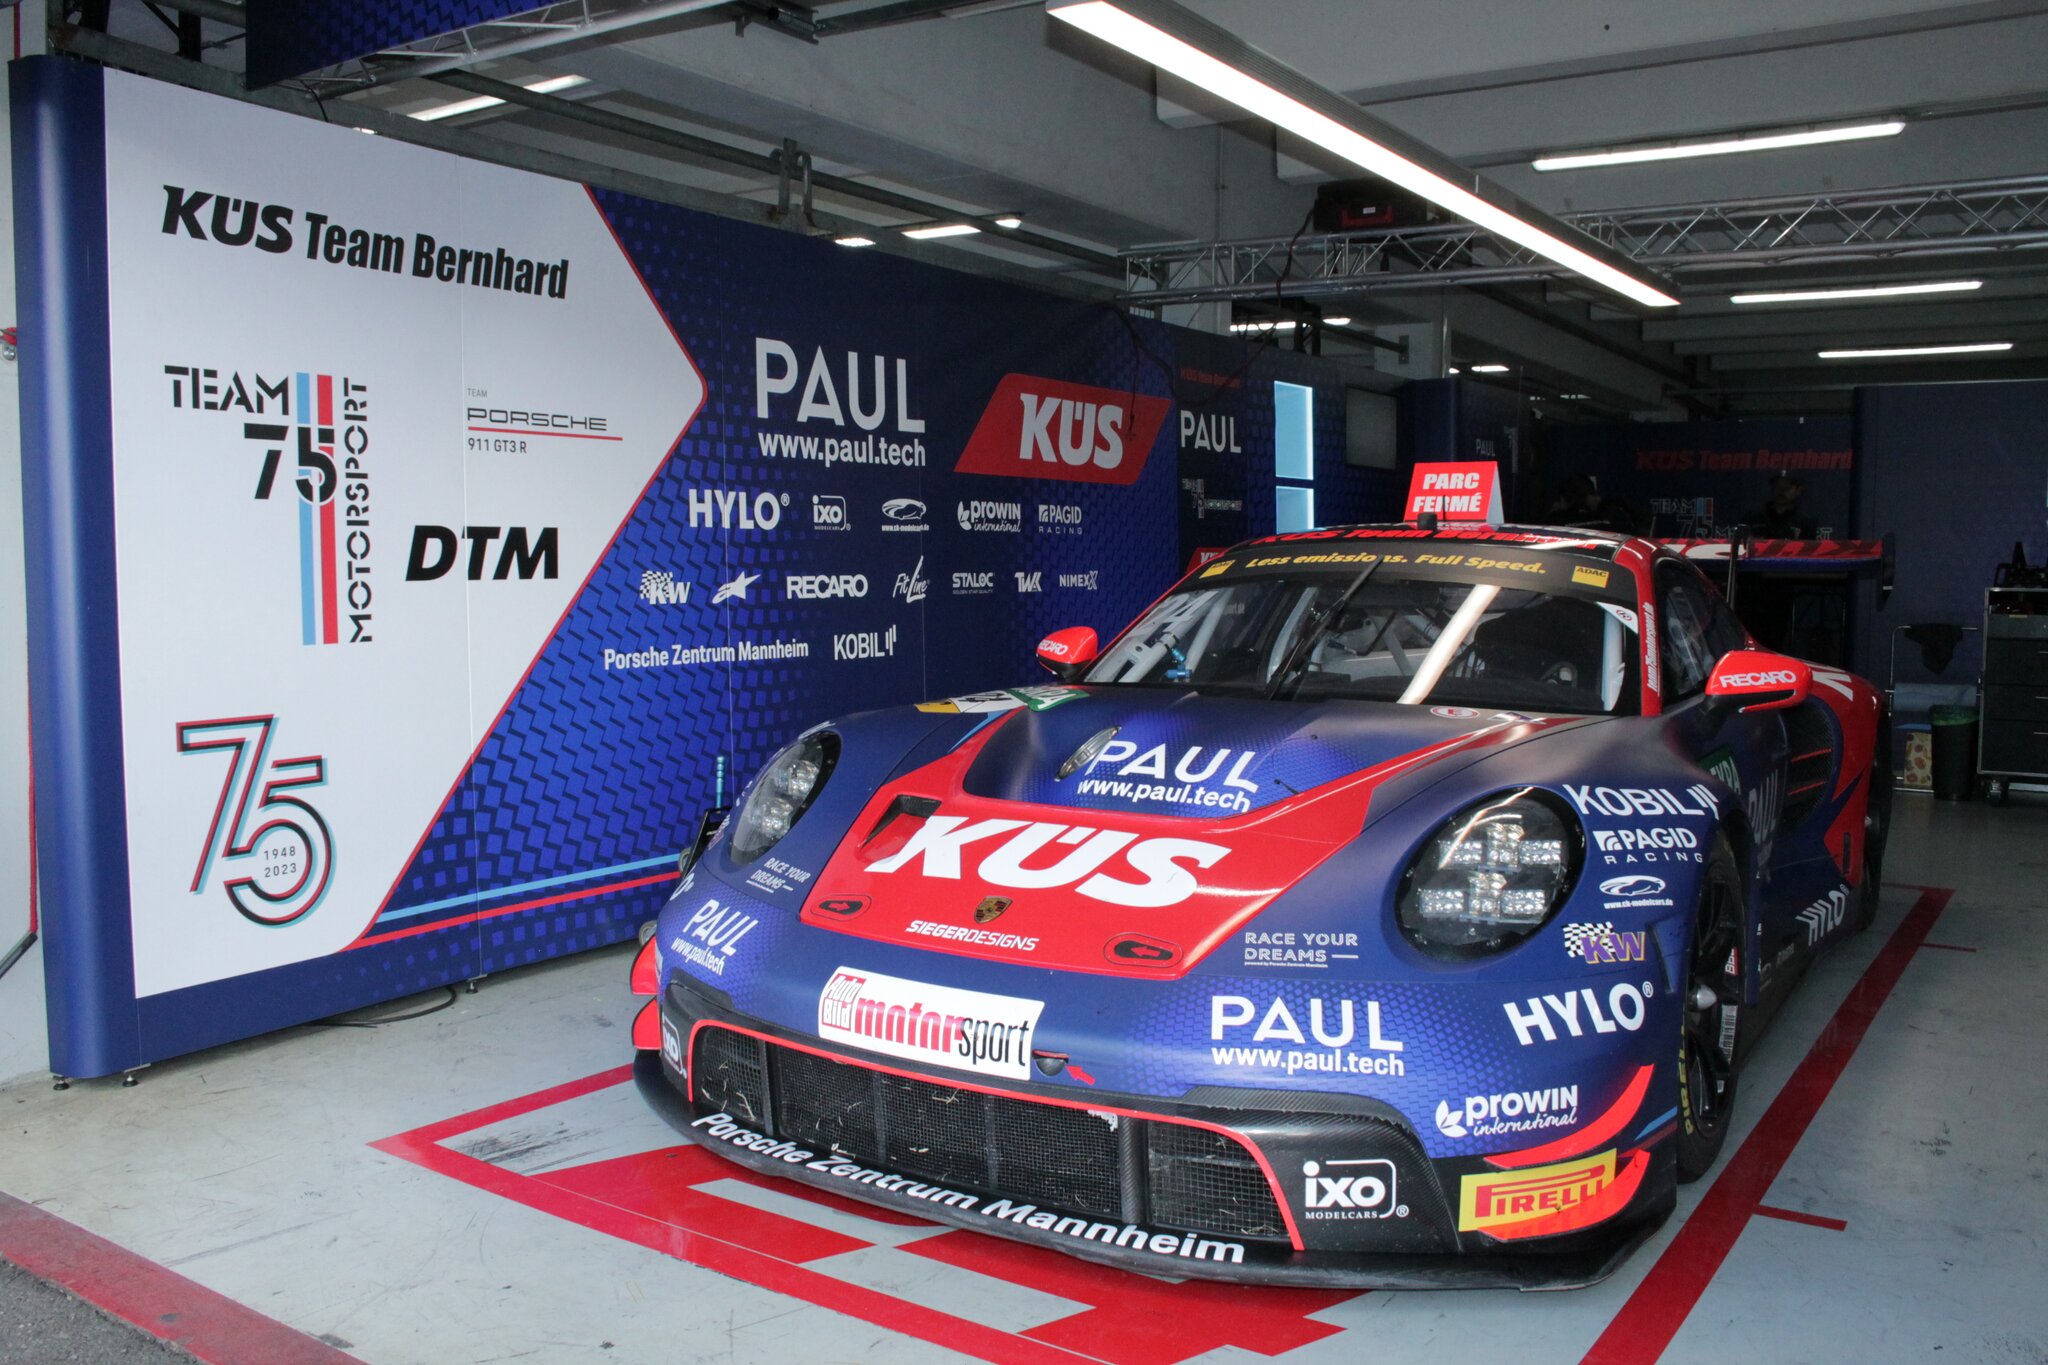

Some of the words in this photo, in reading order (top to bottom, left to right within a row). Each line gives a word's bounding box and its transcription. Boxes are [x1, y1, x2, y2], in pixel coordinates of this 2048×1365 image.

[162, 184, 293, 253] KÜS
[305, 213, 404, 274] Team
[412, 233, 569, 300] Bernhard
[164, 364, 290, 416] TEAM
[467, 387, 488, 398] TEAM
[755, 337, 926, 434] PAUL
[467, 408, 608, 431] PORSCHE
[1019, 392, 1124, 469] KÜS
[1180, 410, 1242, 454] PAUL
[468, 438, 490, 451] 911
[494, 439, 517, 453] GT3
[520, 441, 527, 453] R
[758, 432, 926, 468] www.paul.tech
[1699, 450, 1749, 470] Team
[1756, 449, 1853, 470] Bernhard
[244, 423, 338, 505] 75
[1422, 472, 1480, 490] PARC
[343, 377, 373, 643] MOTORSPORT
[812, 495, 843, 524] ixo
[1050, 505, 1082, 524] PAGID
[1412, 492, 1482, 513] FERMÉ
[1651, 498, 1696, 514] TEAM
[974, 517, 1022, 533] international
[1039, 526, 1083, 535] RACING
[405, 525, 559, 581] DTM
[1245, 554, 1291, 568] Less
[1415, 554, 1465, 566] Full
[1464, 556, 1547, 574] Speed.
[787, 574, 869, 599] RECARO
[952, 572, 994, 588] STALOC
[1575, 567, 1608, 578] ADAC
[649, 580, 691, 604] KW
[604, 648, 669, 670] Porsche
[672, 644, 735, 665] Zentrum
[738, 639, 809, 661] Mannheim
[834, 631, 886, 660] KOBIL
[1719, 670, 1797, 688] RECARO
[1085, 740, 1260, 794] PAUL
[1077, 778, 1253, 813] www.paul.tech
[1562, 784, 1705, 816] KOBIL
[176, 714, 338, 929] 75
[1617, 828, 1698, 849] PAGID
[263, 845, 297, 861] 1948
[864, 814, 1233, 909] KÜS
[1604, 852, 1703, 865] RACING
[264, 862, 298, 878] 2023
[750, 869, 786, 890] DREAMS
[764, 857, 788, 874] RACE
[787, 866, 811, 883] YOUR
[682, 899, 759, 957] PAUL
[905, 919, 1040, 951] SIEGERDESIGNS
[1245, 932, 1296, 945] RACE
[1303, 933, 1358, 946] YOUR
[671, 937, 726, 977] www.paul.tech
[1244, 948, 1327, 962] DREAMS
[1581, 932, 1646, 964] KW
[826, 975, 864, 1003] Auto
[823, 998, 851, 1030] Bild
[1211, 995, 1404, 1051] PAUL
[1212, 1047, 1405, 1076] www.paul.tech
[1473, 1108, 1577, 1136] international
[690, 1110, 813, 1164] Porsche
[806, 1154, 988, 1211] Zentrum
[981, 1197, 1246, 1264] Mannheim
[1303, 1160, 1386, 1208] ixo
[1474, 1165, 1606, 1219] PIRELLI
[1305, 1211, 1378, 1220] MODELCARS
